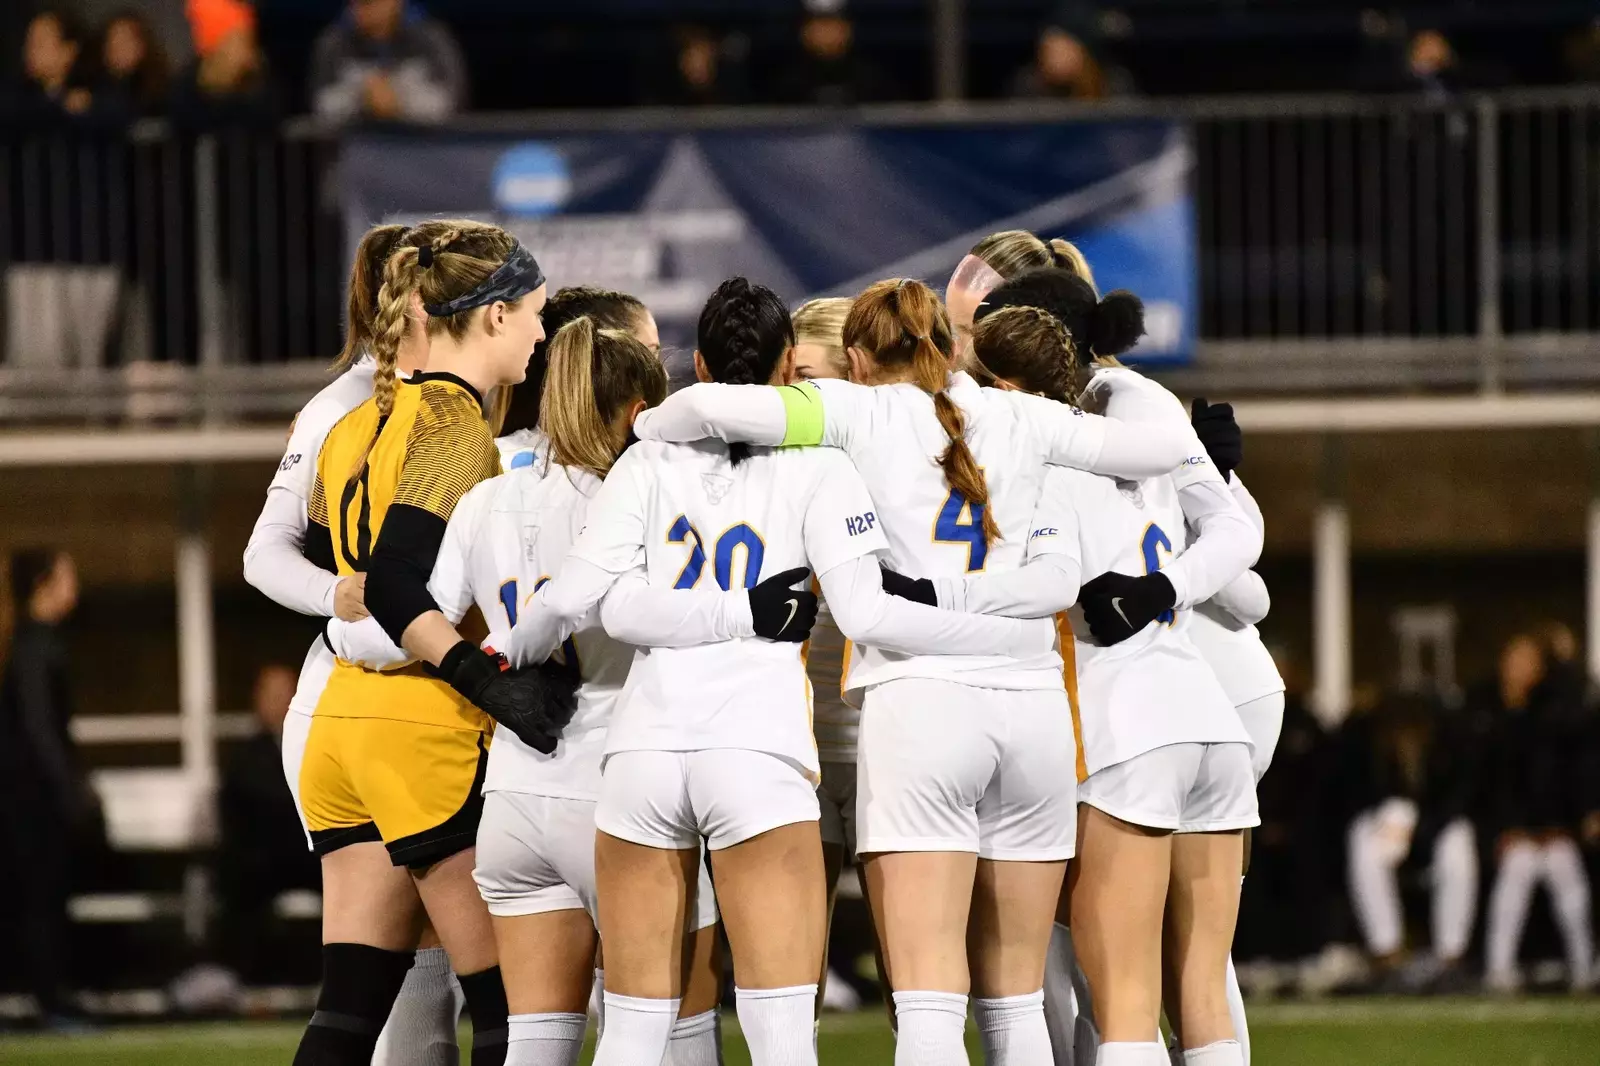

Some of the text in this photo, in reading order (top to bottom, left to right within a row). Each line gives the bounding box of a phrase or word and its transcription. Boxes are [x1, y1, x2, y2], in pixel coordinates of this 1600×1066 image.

[845, 511, 875, 537] H2P
[931, 466, 986, 573] 4
[1030, 527, 1058, 540] ACC
[665, 513, 766, 592] 20
